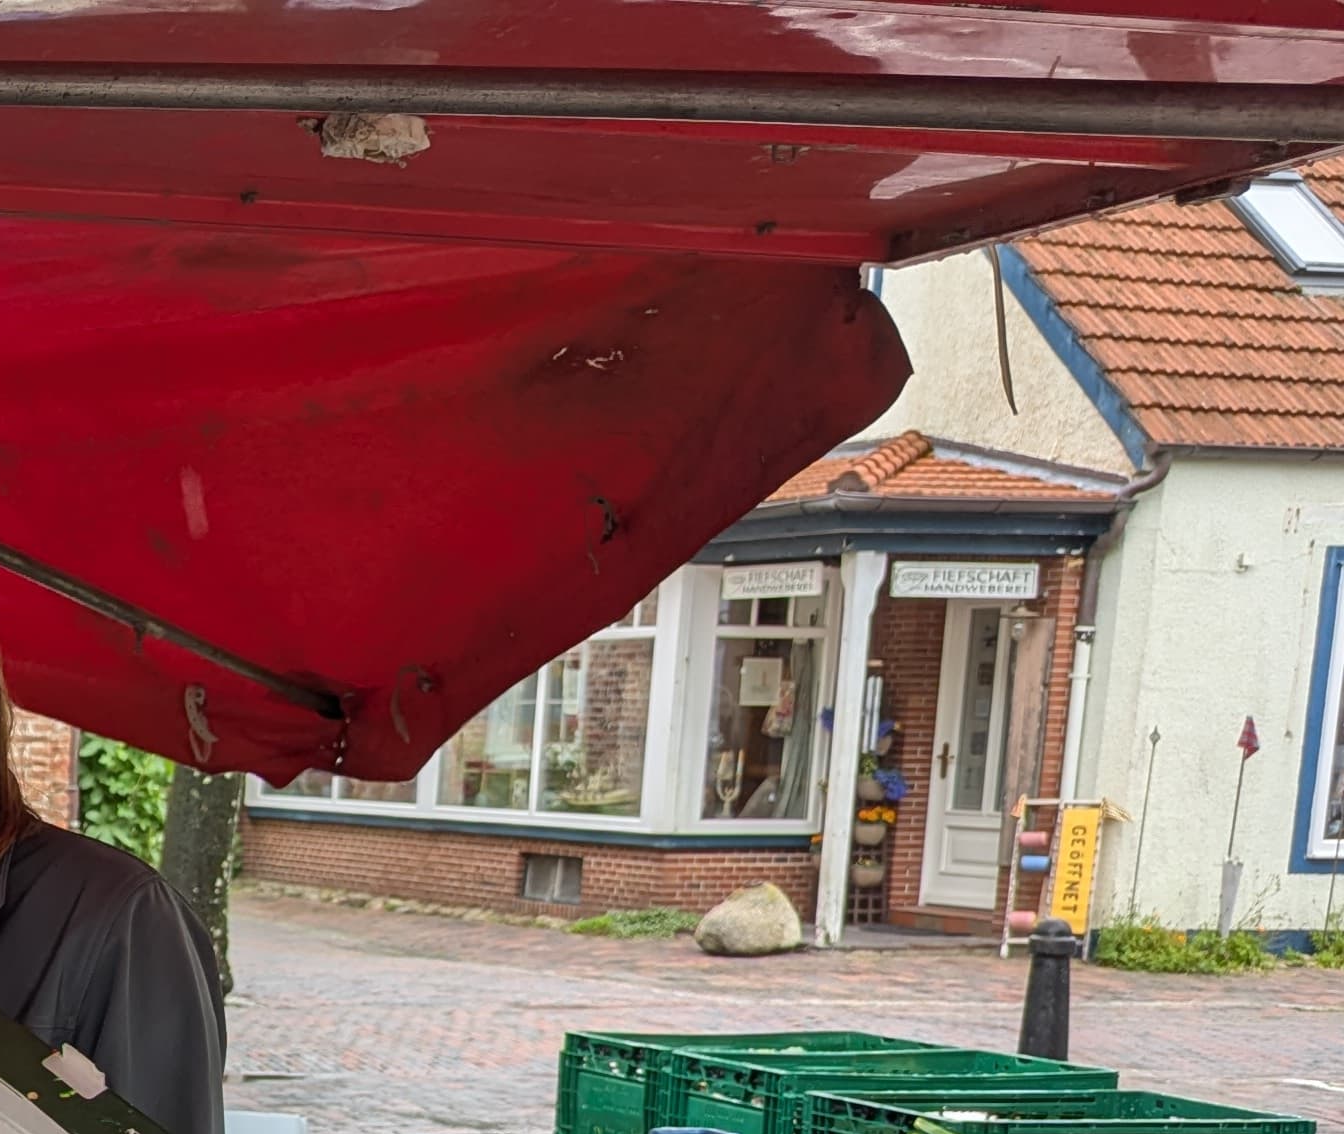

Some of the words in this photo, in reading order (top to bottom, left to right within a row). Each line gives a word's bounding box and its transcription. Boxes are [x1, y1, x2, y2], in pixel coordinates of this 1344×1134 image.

[933, 571, 1030, 584] FIEFSCHAFT
[924, 583, 1029, 594] HANDWEBEREI
[1062, 825, 1087, 914] GEÖFFNET
